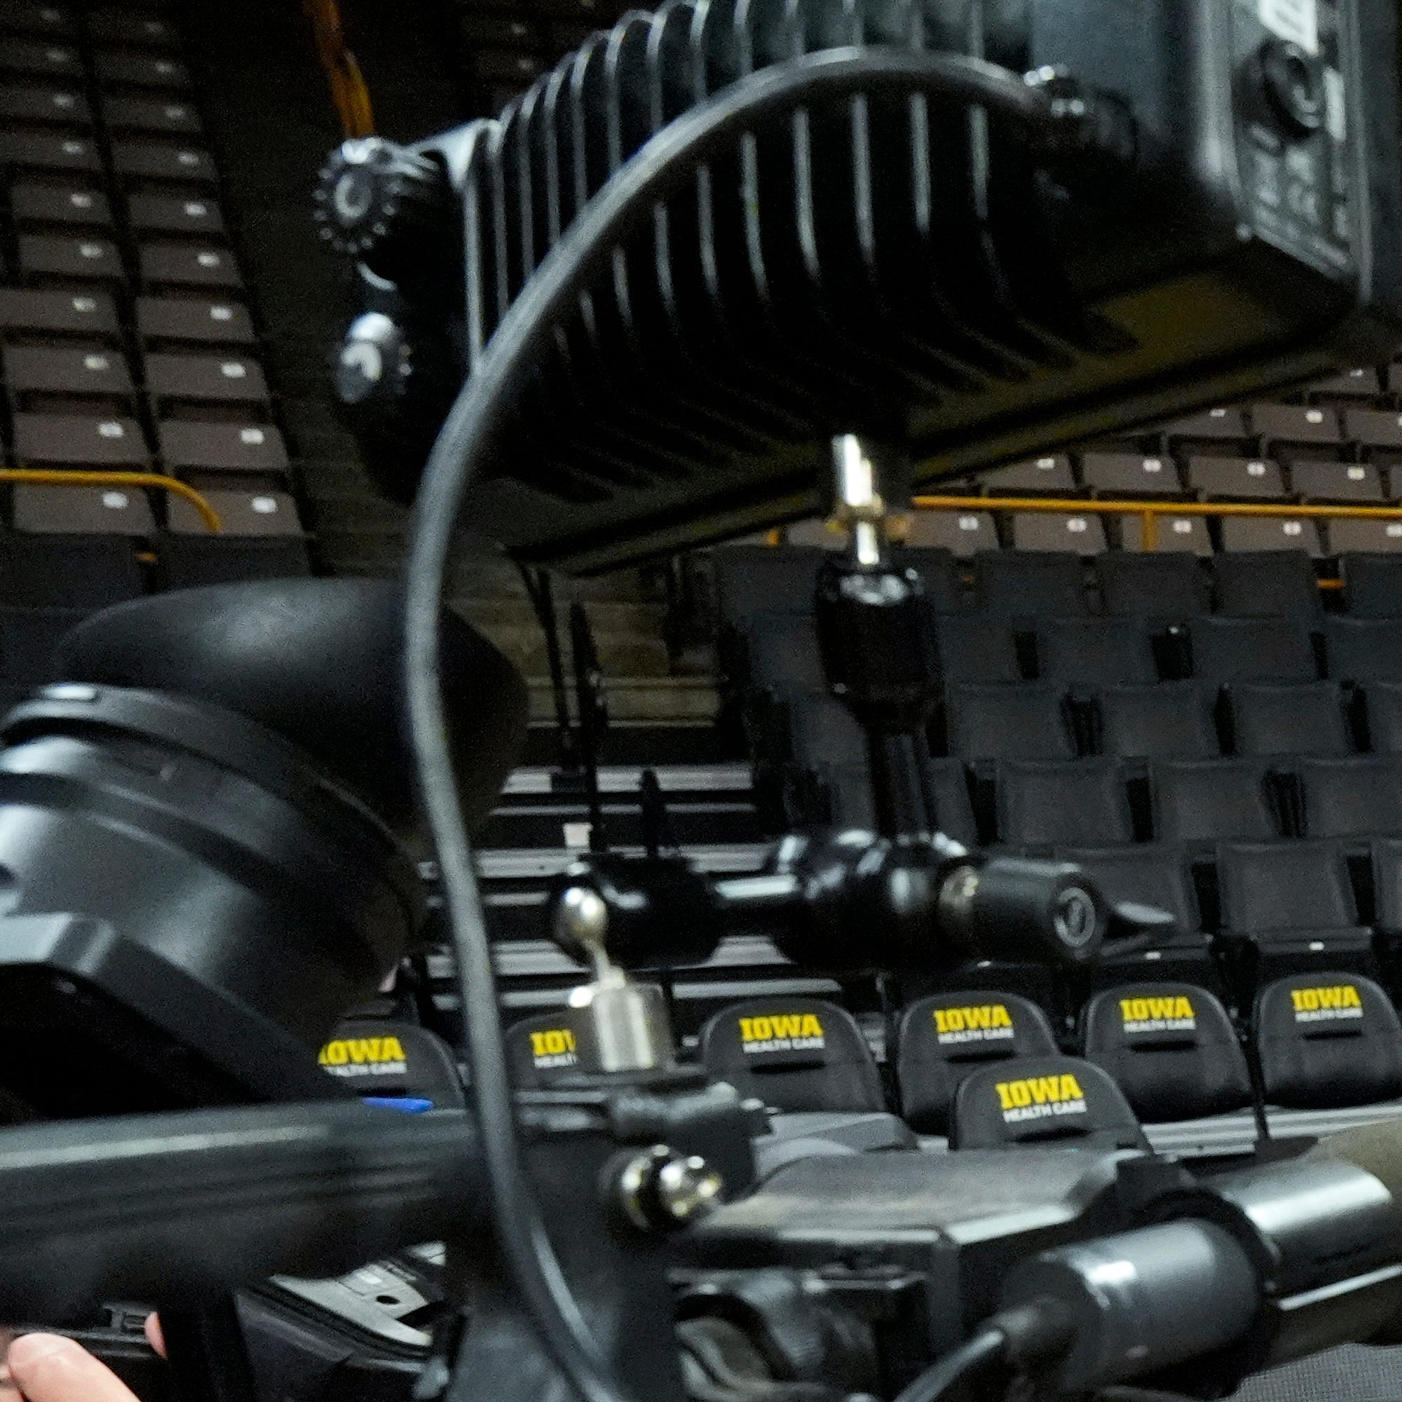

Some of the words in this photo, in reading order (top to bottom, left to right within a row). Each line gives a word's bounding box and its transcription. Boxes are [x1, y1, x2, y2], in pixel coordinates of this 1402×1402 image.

[1120, 996, 1195, 1022] IOWA
[1291, 985, 1361, 1012] IOWA
[739, 1013, 824, 1042] IOWA
[933, 1004, 1012, 1034] IOWA
[995, 1073, 1084, 1110] IOWA
